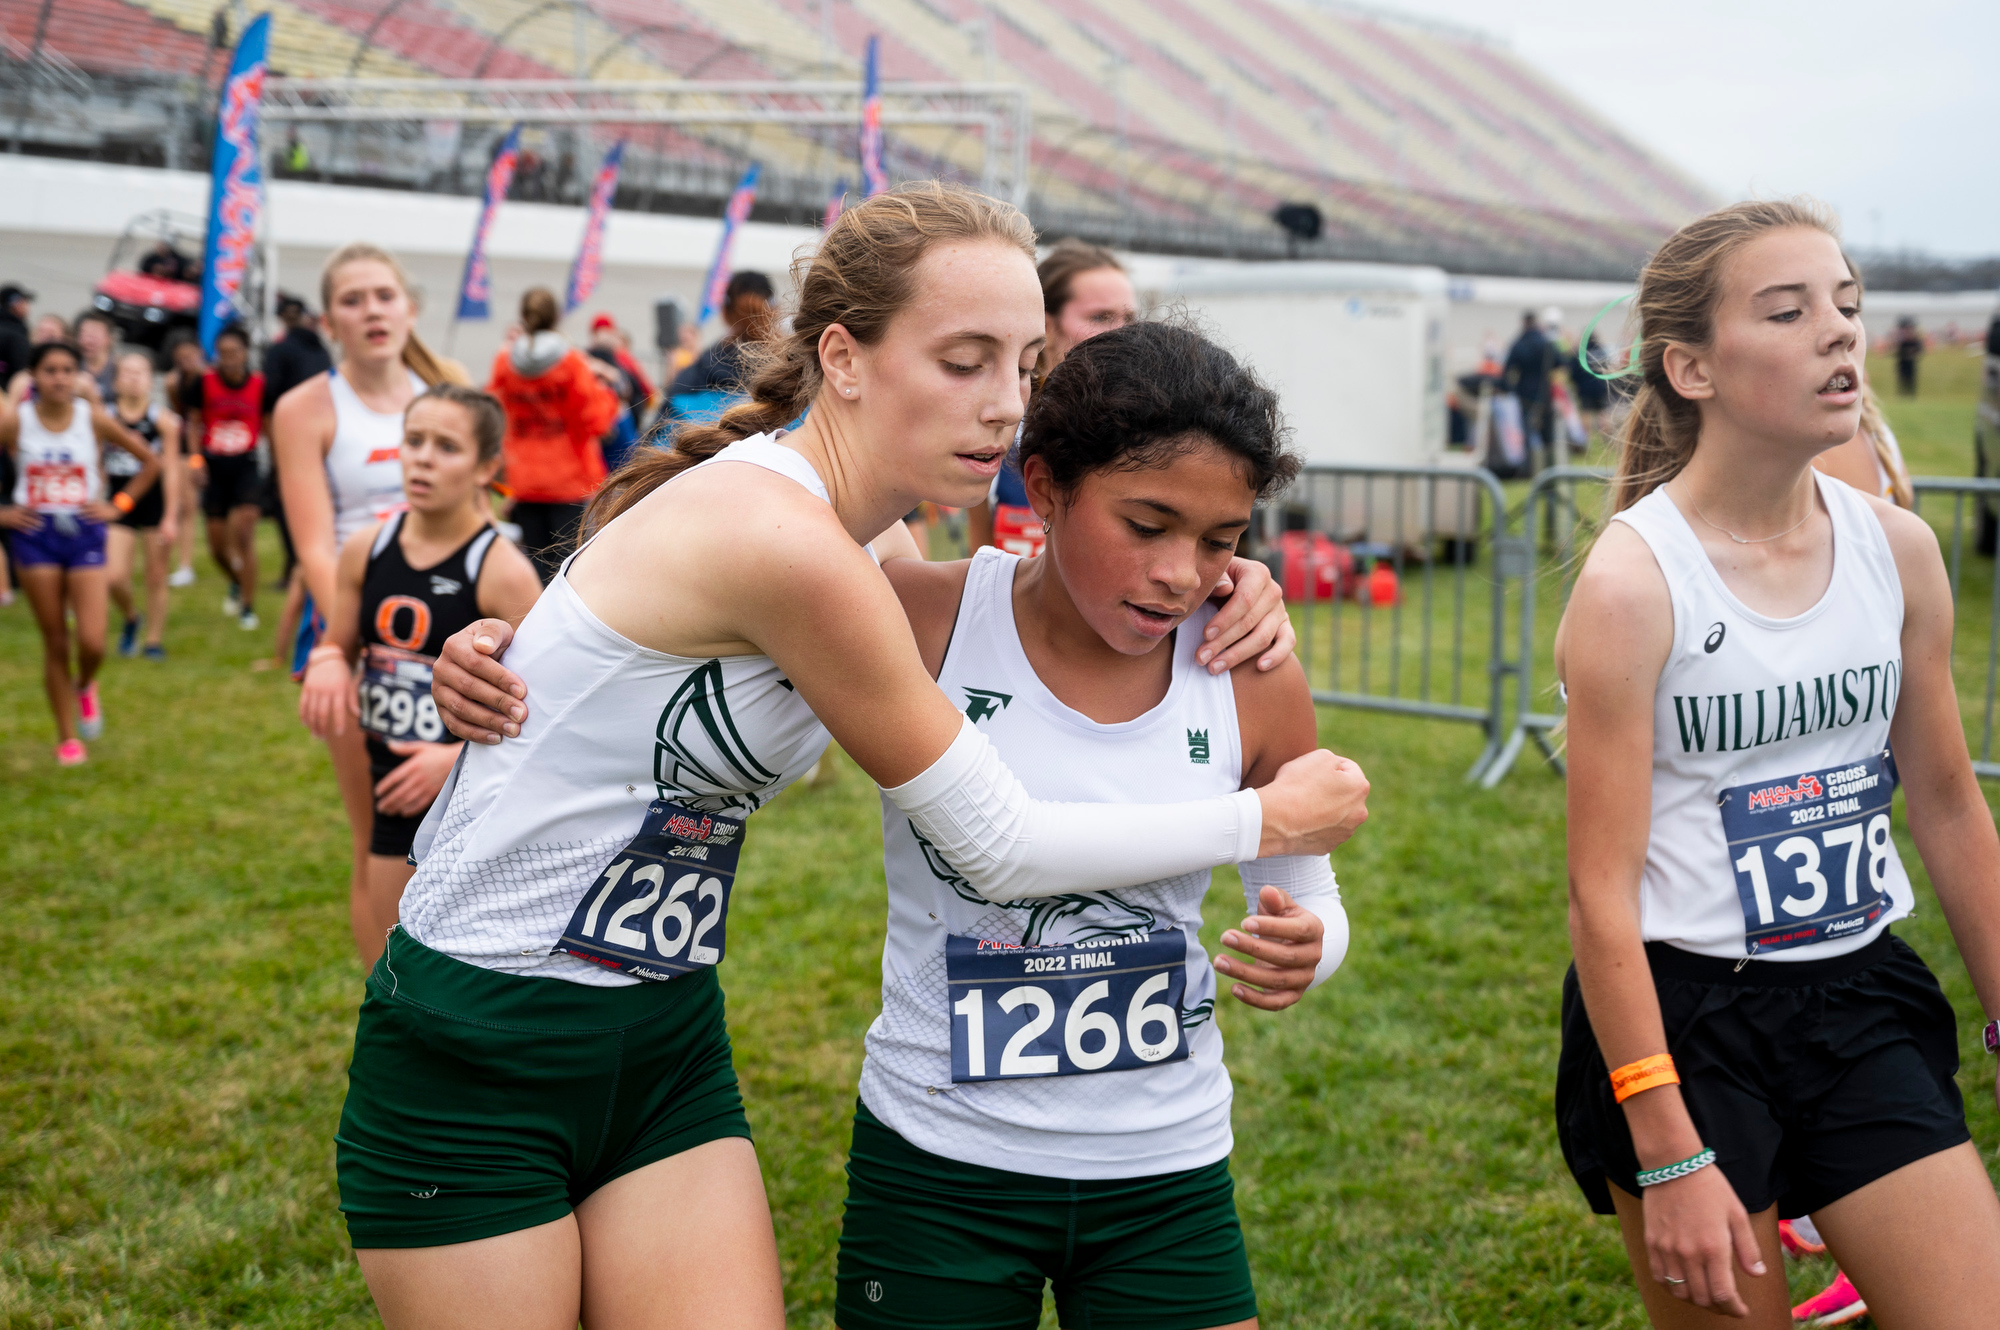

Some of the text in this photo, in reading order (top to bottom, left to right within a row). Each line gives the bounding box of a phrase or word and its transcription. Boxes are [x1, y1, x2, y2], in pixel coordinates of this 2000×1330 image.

[359, 681, 444, 742] 1298
[1673, 658, 1901, 753] WILLIAMSTO
[1826, 765, 1868, 786] CROSS
[1828, 774, 1879, 799] COUNTRY
[1748, 777, 1818, 810] MHSAA
[1790, 797, 1861, 825] 2022 FINAL
[1735, 814, 1891, 925] 1378
[581, 859, 723, 965] 1262
[569, 949, 622, 970] WEAR ON FRONT
[1024, 952, 1115, 973] 2022 FINAL
[954, 972, 1180, 1077] 1266
